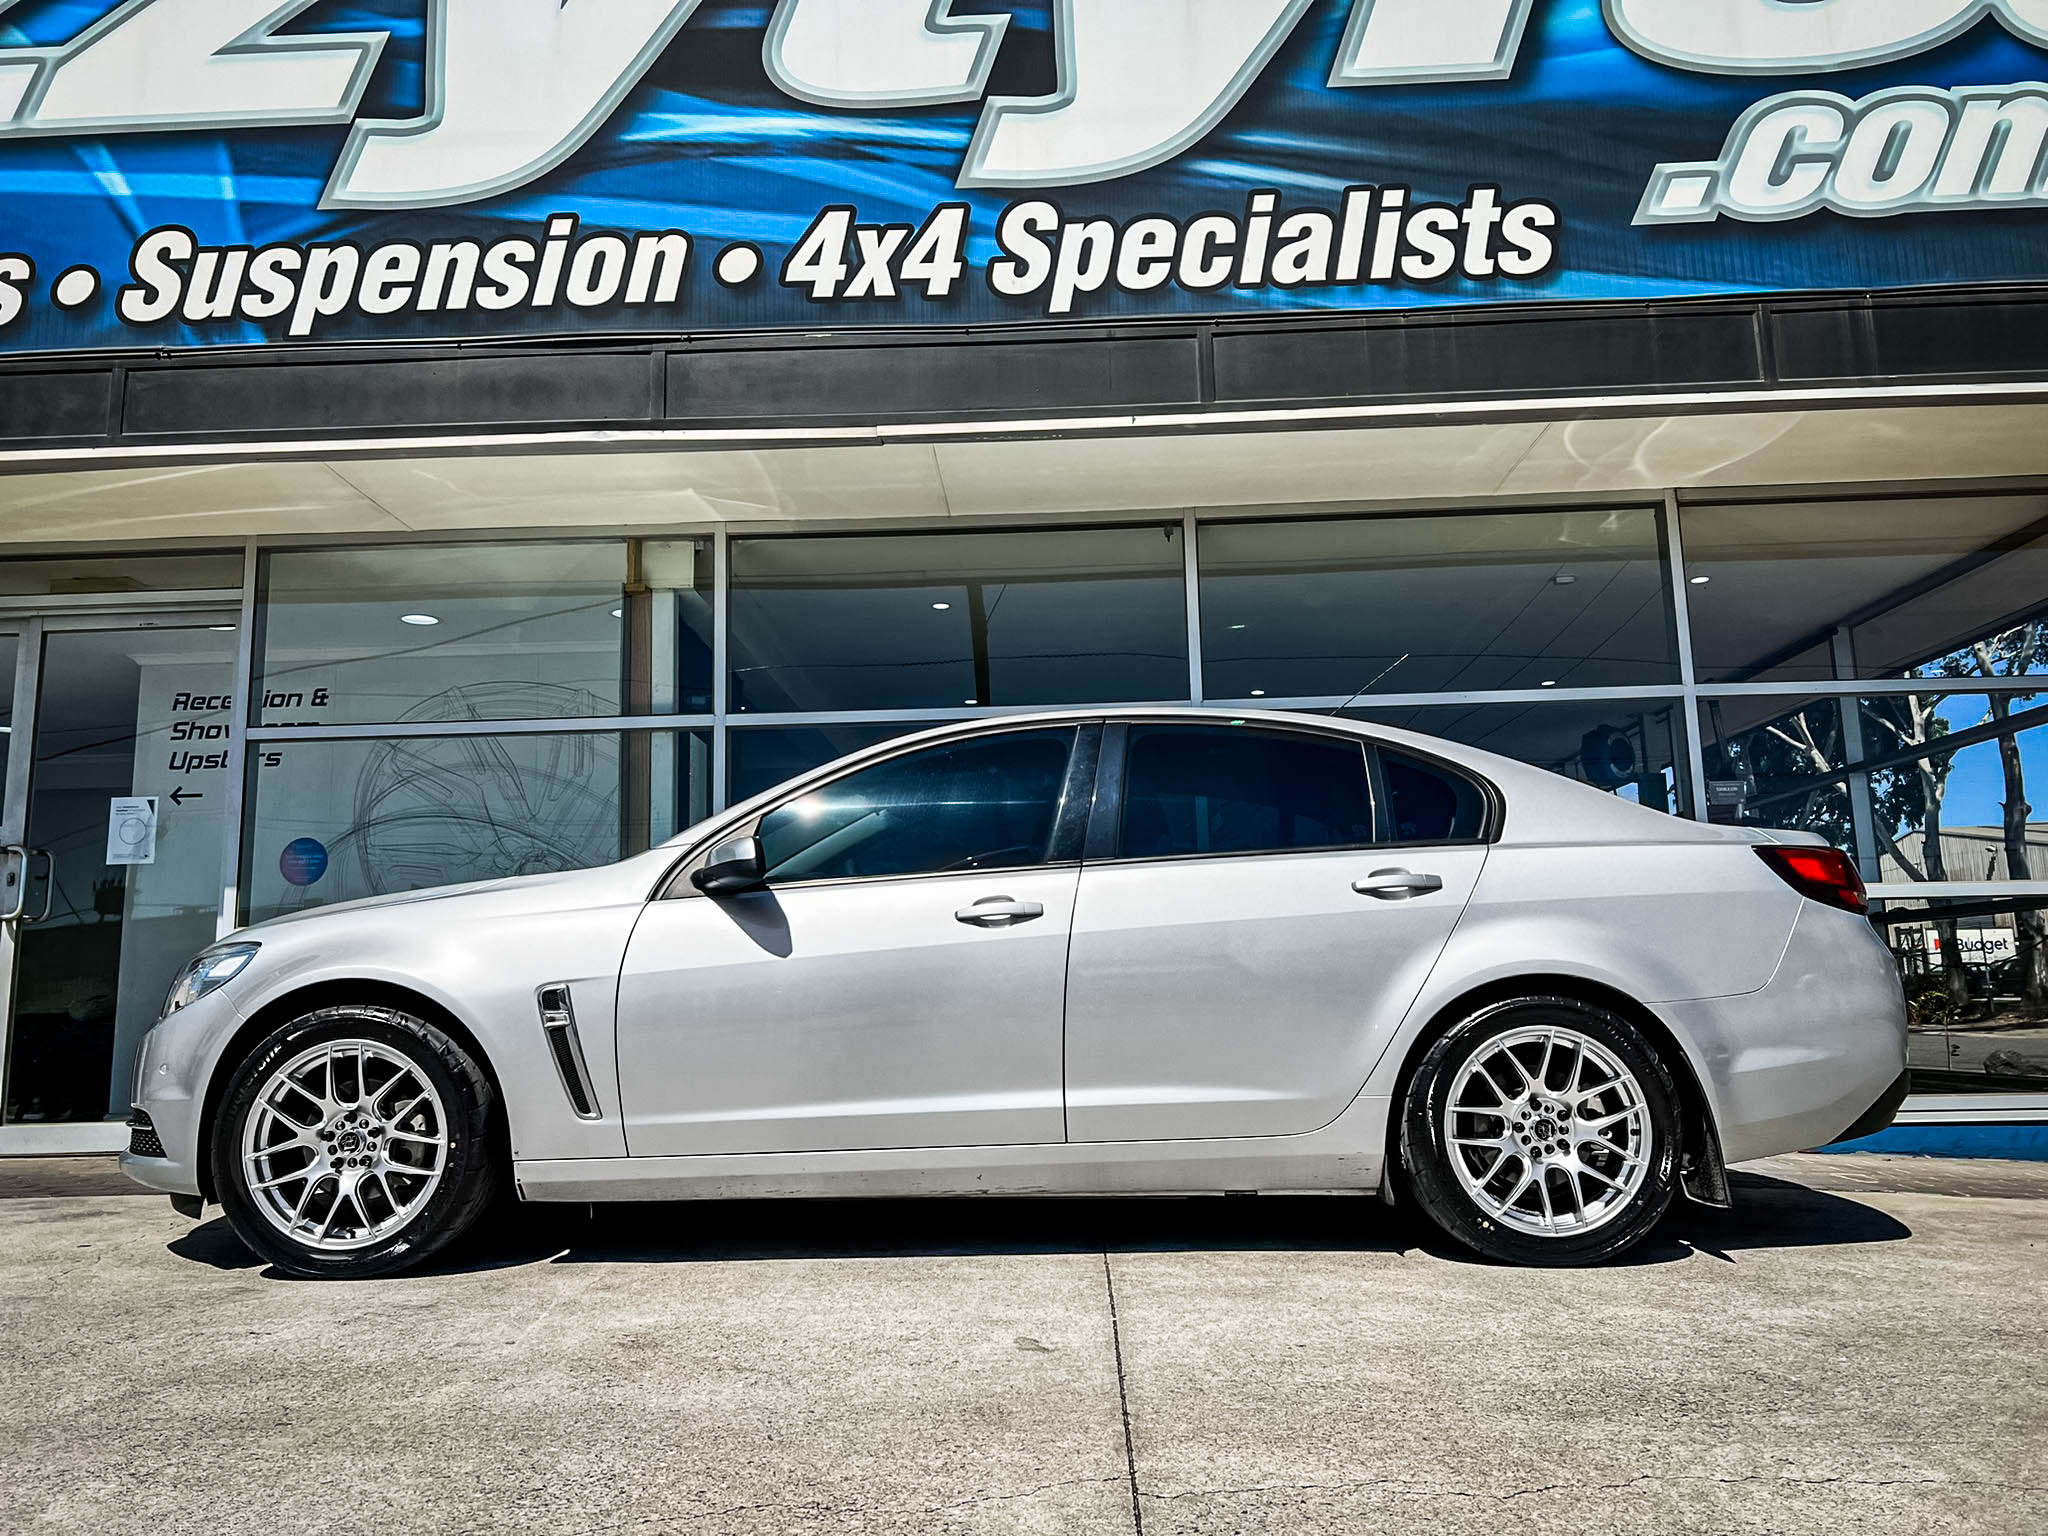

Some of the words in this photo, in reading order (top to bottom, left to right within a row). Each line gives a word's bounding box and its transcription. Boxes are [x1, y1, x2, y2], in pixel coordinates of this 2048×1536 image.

[122, 215, 690, 338] Suspension
[784, 204, 968, 300] 4x4
[990, 185, 1558, 316] Specialists
[171, 689, 304, 711] Receion
[310, 687, 329, 707] &
[1957, 938, 2008, 954] Budget
